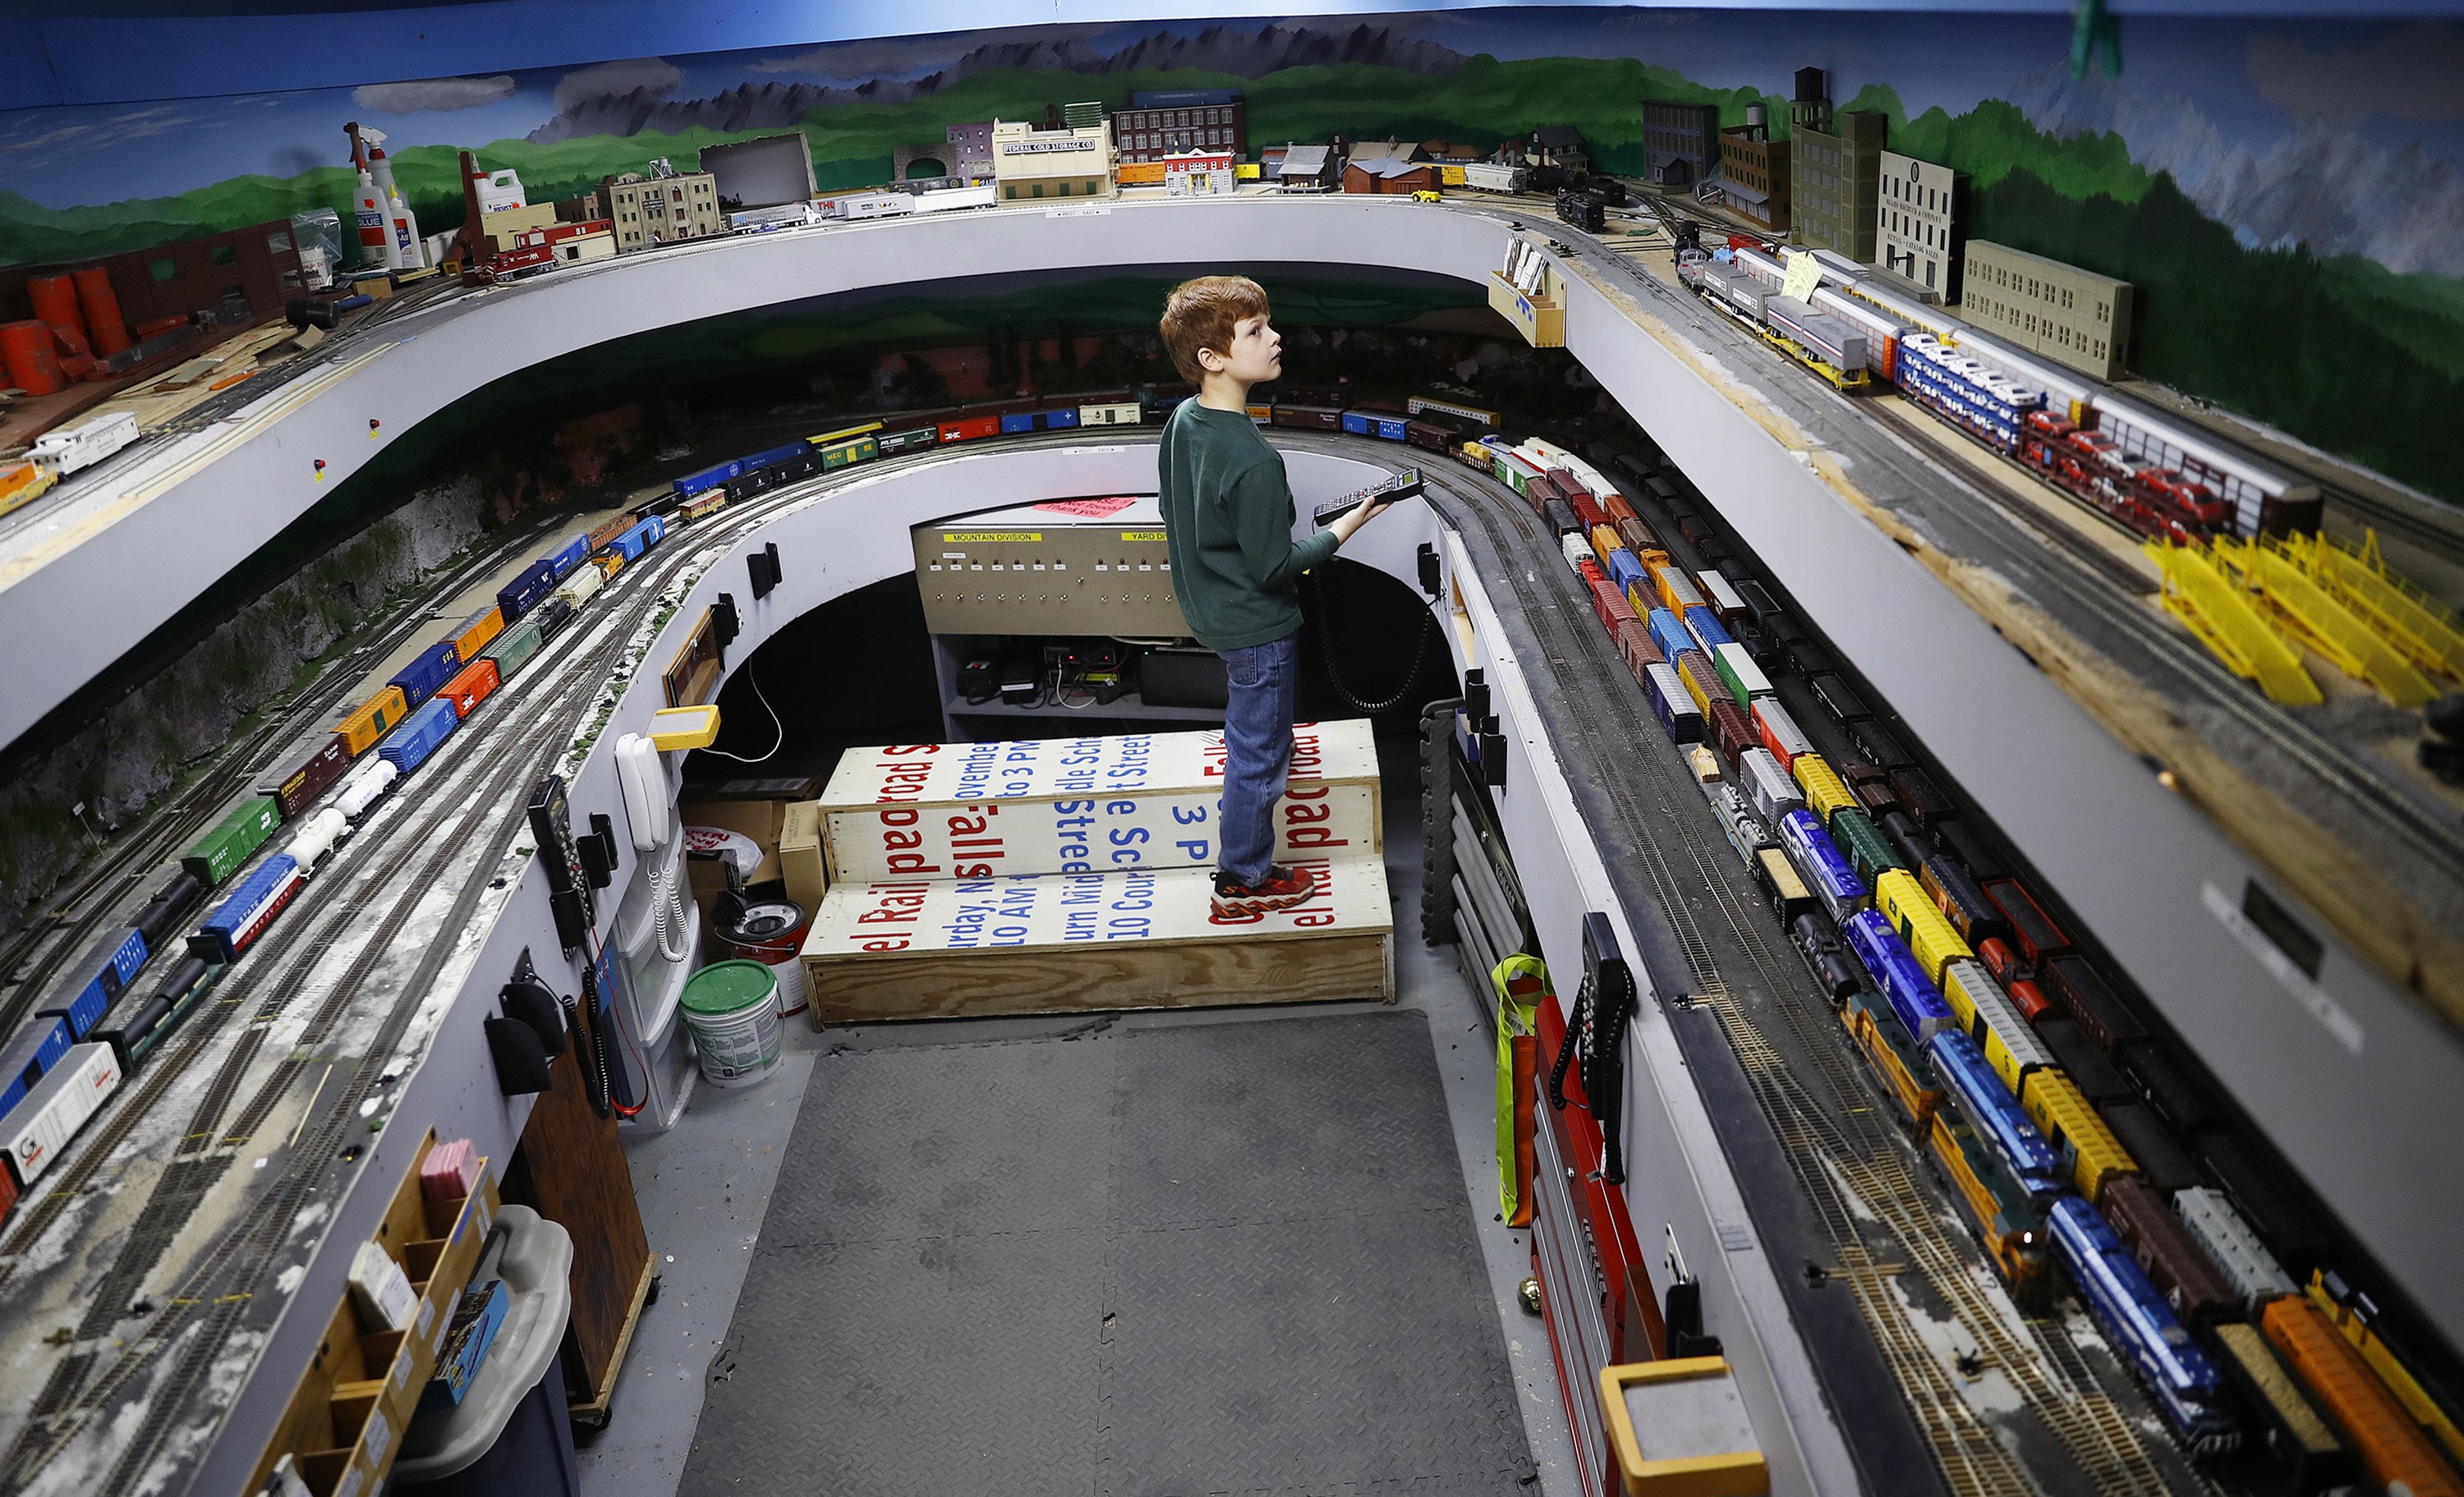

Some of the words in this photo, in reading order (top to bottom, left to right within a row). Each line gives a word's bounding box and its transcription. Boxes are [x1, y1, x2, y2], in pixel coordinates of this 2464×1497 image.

[1005, 145, 1032, 153] FEDERAL
[1050, 142, 1080, 150] STORAGE
[356, 218, 380, 227] GLUE
[1886, 199, 1899, 209] SEARS
[1922, 210, 1942, 224] COMPANY
[1887, 233, 1902, 245] RETAIL
[1905, 241, 1924, 254] CATALOG
[1925, 249, 1938, 259] SALES
[826, 452, 842, 461] MEC
[954, 534, 995, 542] MOUNTAIN
[1060, 737, 1103, 765] Sch
[1107, 735, 1152, 778] Street
[1172, 805, 1207, 825] 3
[238, 899, 260, 924] STATE
[271, 867, 290, 889] MAINE
[857, 882, 931, 924] Rail
[999, 888, 1037, 918] AM
